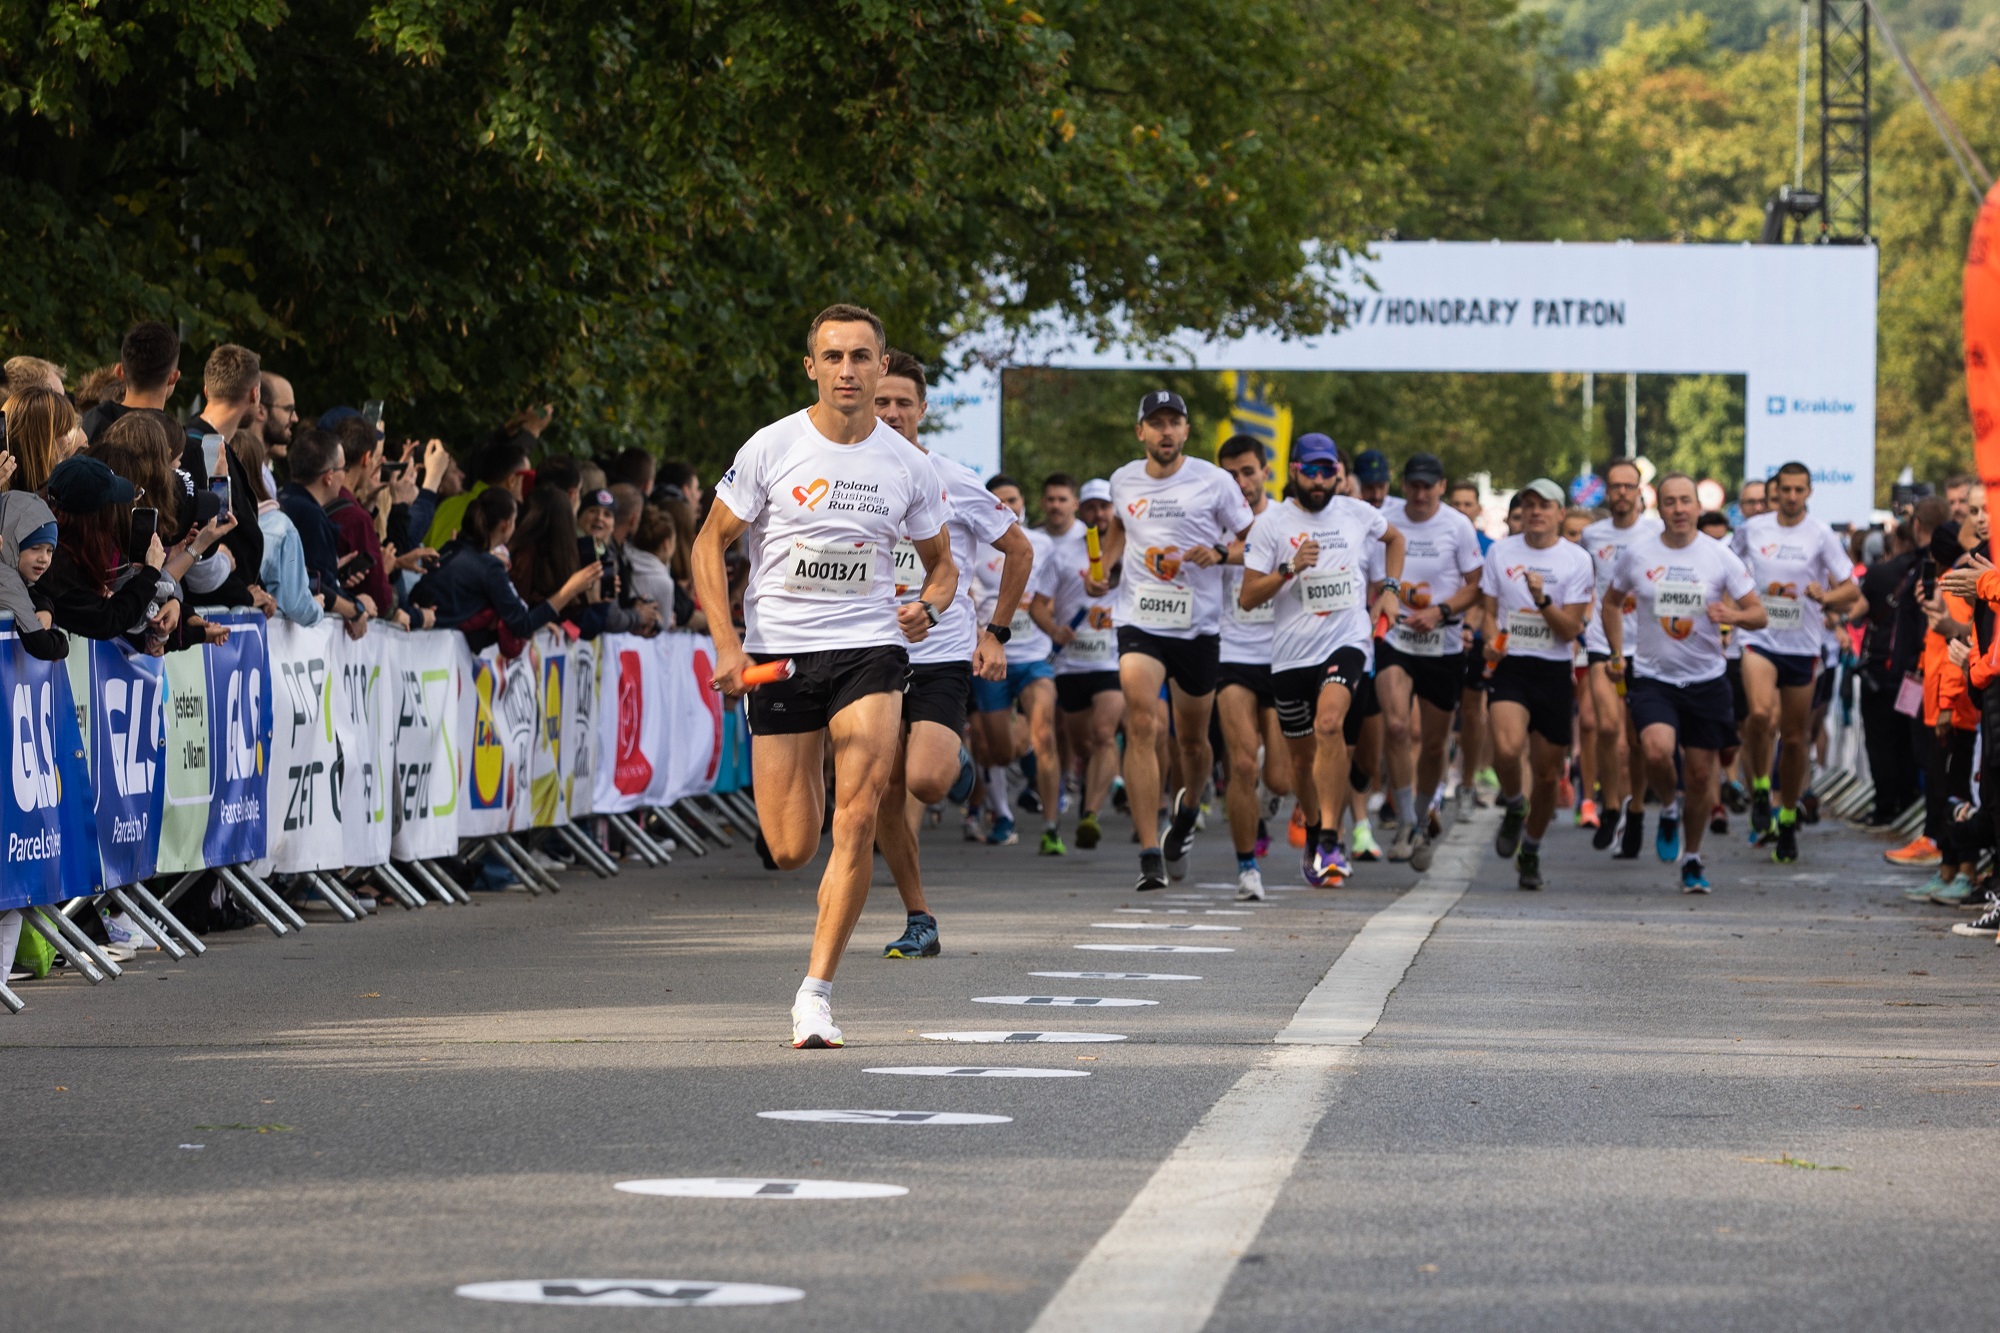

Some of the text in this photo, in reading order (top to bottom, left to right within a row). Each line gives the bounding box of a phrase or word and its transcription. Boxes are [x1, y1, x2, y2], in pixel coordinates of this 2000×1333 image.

[1533, 298, 1625, 326] PATRON
[831, 490, 885, 505] Business
[834, 480, 879, 494] Poland
[828, 500, 890, 516] Run 2022
[795, 559, 867, 581] A0013/1
[890, 552, 915, 570] 7/1
[1307, 581, 1351, 599] B0100/1
[226, 668, 261, 782] GLS
[12, 681, 57, 813] GLS
[186, 738, 206, 770] Wami
[112, 815, 137, 844] Parcels
[8, 827, 50, 863] Parcels
